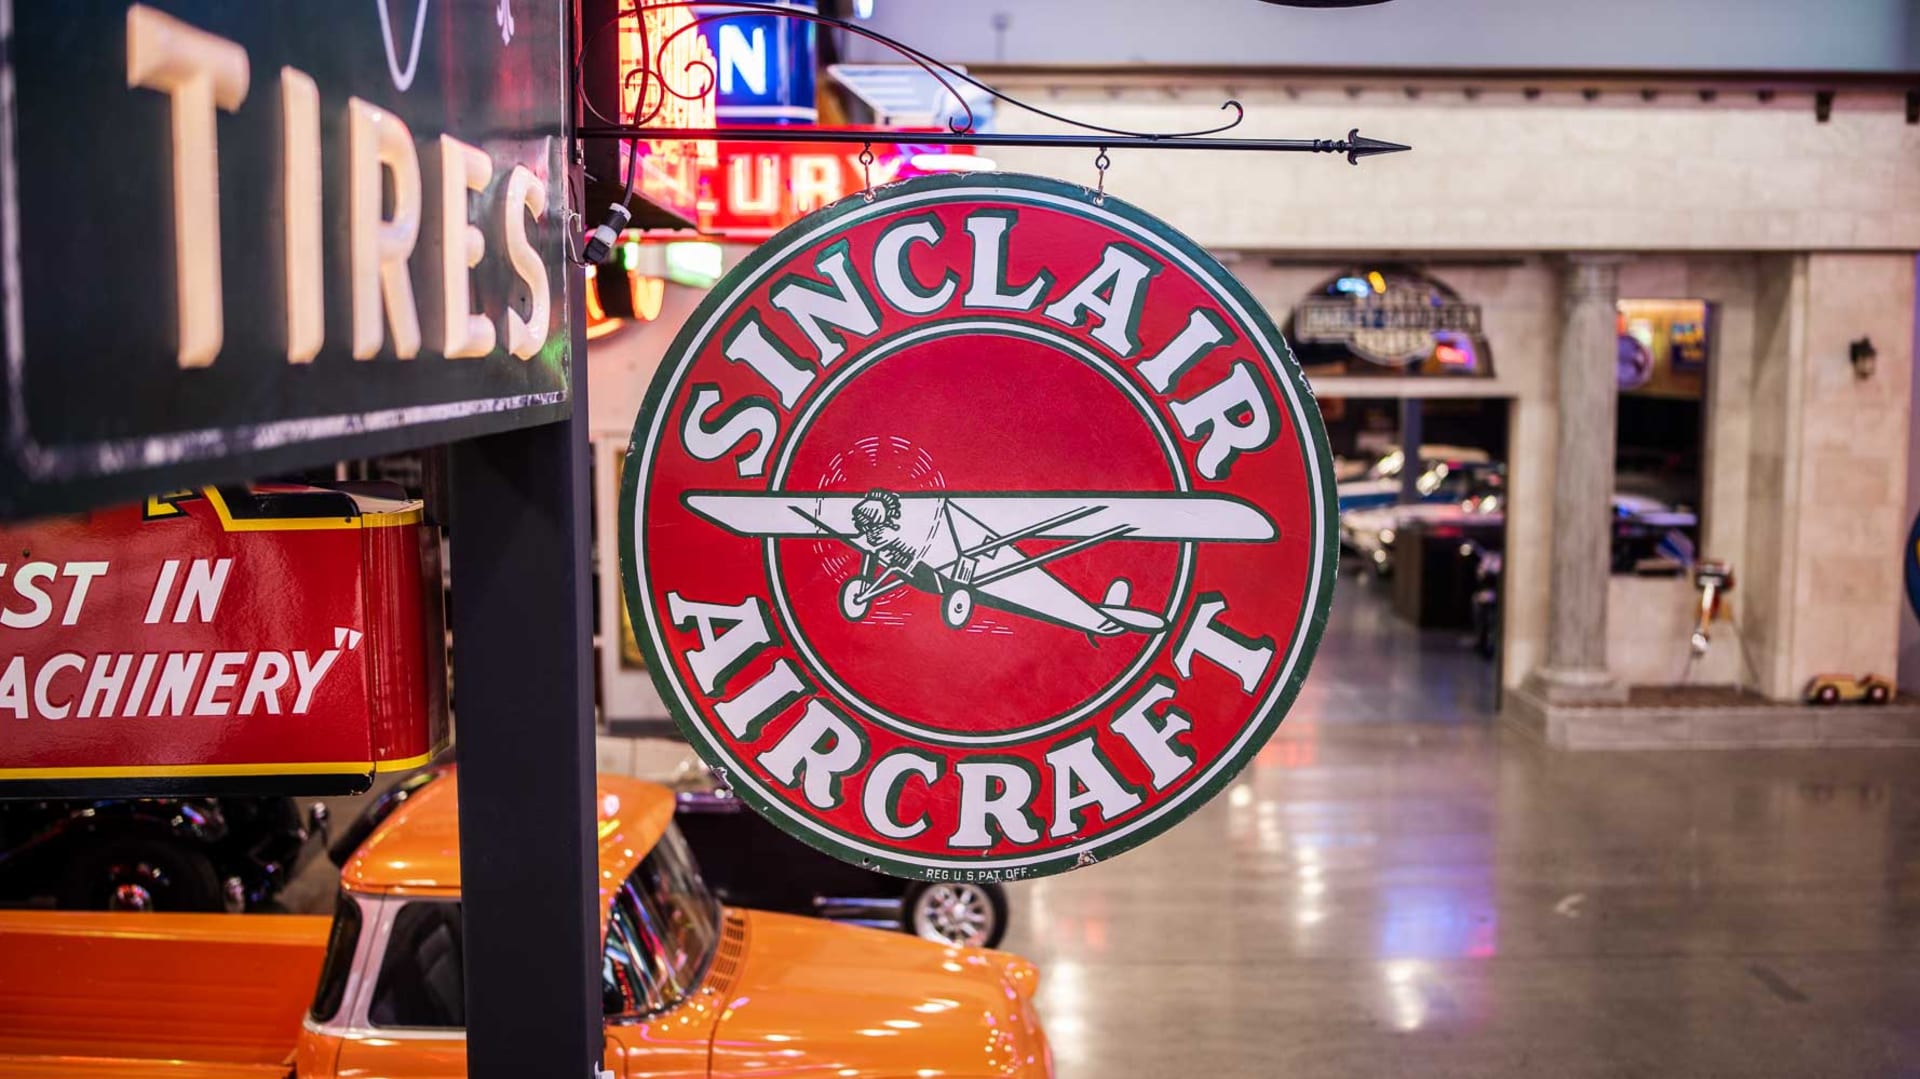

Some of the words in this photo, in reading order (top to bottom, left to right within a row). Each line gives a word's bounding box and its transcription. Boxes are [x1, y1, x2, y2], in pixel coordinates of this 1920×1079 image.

[126, 3, 551, 370] TIRES
[681, 211, 1280, 480] SINCLAIR
[0, 561, 109, 629] ST
[144, 558, 232, 624] IN
[667, 592, 1277, 849] AIRCRAFT
